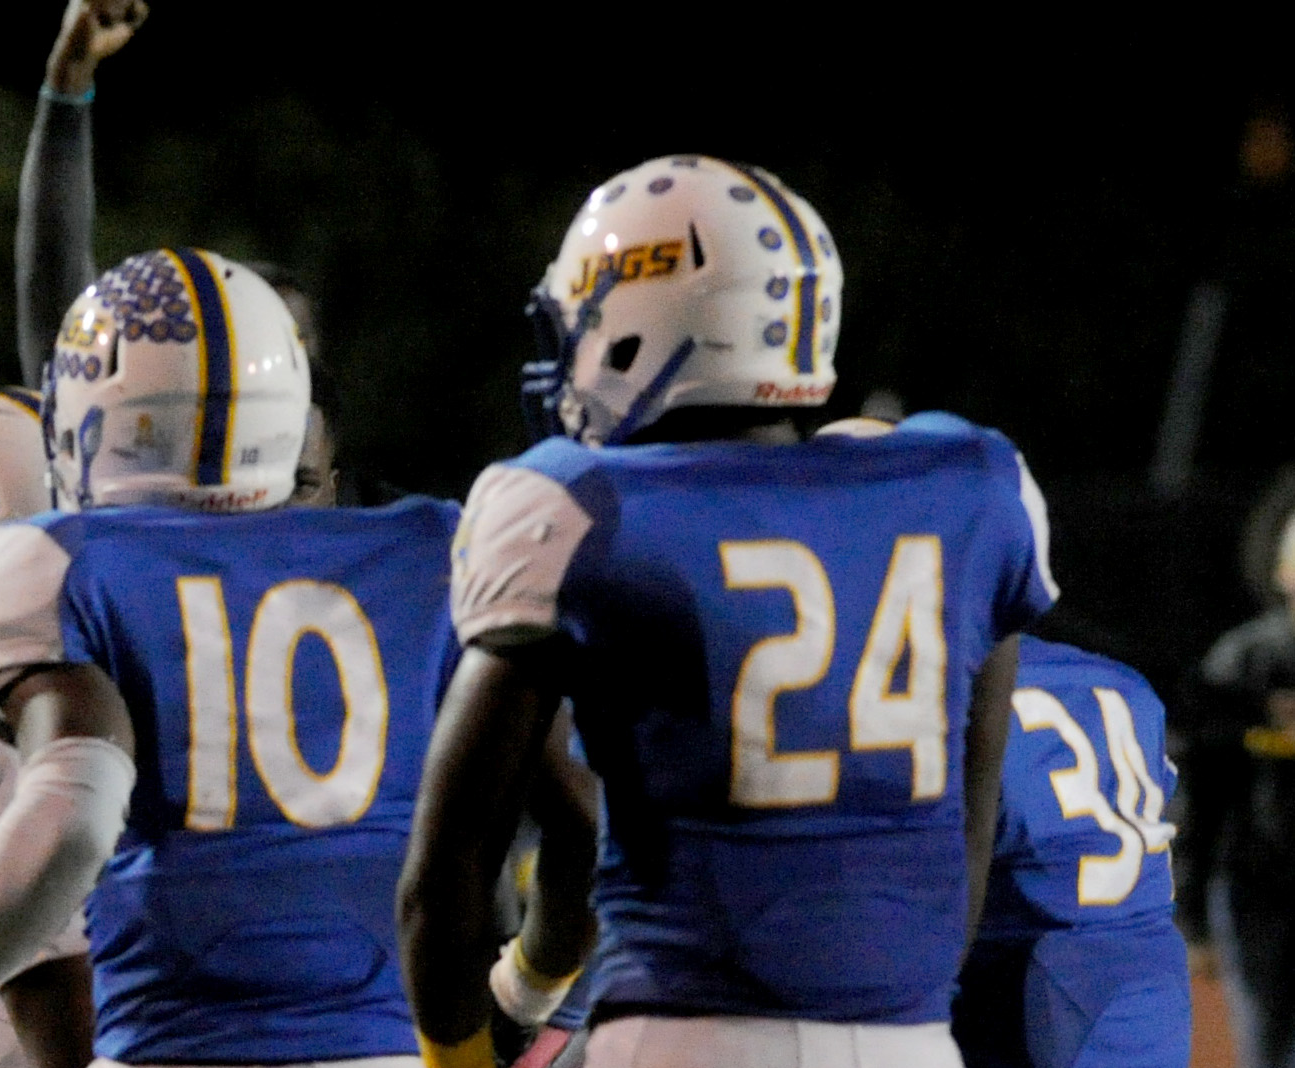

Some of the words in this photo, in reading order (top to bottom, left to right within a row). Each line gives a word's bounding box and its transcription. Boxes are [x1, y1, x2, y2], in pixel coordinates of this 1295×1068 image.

[175, 575, 389, 831] 10
[718, 533, 948, 809] 24
[1010, 686, 1178, 905] 34
